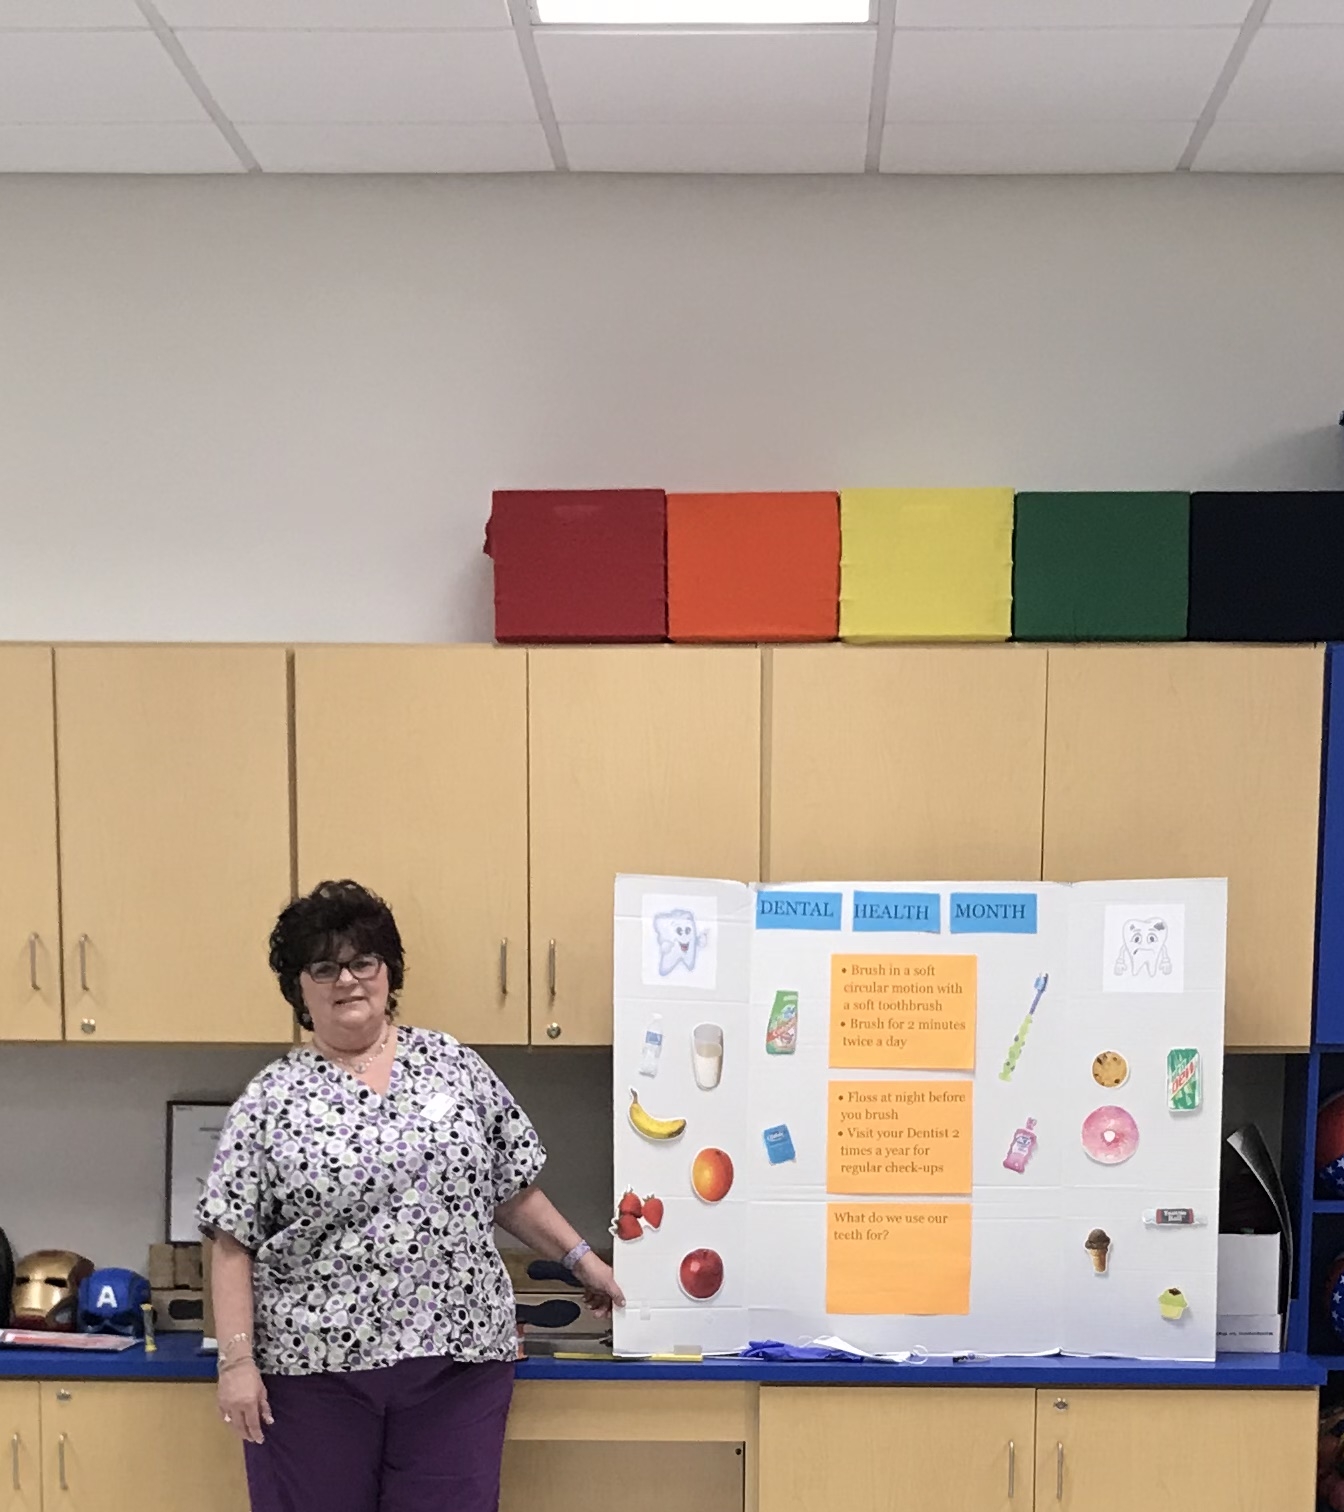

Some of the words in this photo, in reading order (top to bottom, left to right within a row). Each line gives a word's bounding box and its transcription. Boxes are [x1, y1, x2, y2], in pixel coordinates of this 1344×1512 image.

[760, 900, 834, 918] DENTAL
[854, 903, 930, 920] HEALTH
[955, 903, 1026, 919] MONTH
[851, 964, 886, 976] Brush
[889, 964, 901, 976] in
[903, 967, 910, 976] a
[913, 964, 936, 976] soft
[843, 981, 889, 994] circular
[892, 983, 934, 994] motion
[937, 982, 963, 994] with
[843, 1002, 850, 1011] a
[853, 999, 875, 1011] soft
[878, 1000, 943, 1012] toothbrush
[850, 1017, 885, 1030] Brush
[888, 1018, 905, 1030] for
[907, 1021, 915, 1030] 2
[918, 1019, 966, 1030] minutes
[842, 1035, 874, 1047] twice
[876, 1038, 883, 1047] a
[886, 1035, 908, 1050] day
[848, 1091, 878, 1103] Floss
[880, 1092, 892, 1103] at
[895, 1091, 925, 1105] night
[928, 1091, 966, 1103] before
[840, 1111, 862, 1123] you
[865, 1108, 899, 1120] brush
[847, 1127, 874, 1139] Visit
[877, 1130, 904, 1141] your
[907, 1127, 949, 1139] Dentist
[952, 1130, 960, 1139] 2
[840, 1145, 873, 1156] times
[875, 1147, 882, 1156] a
[884, 1147, 911, 1158] year
[913, 1144, 931, 1156] for
[840, 1161, 883, 1175] regular
[884, 1161, 944, 1175] check-ups
[834, 1211, 866, 1223] What
[868, 1211, 884, 1223] do
[885, 1214, 902, 1224] we
[905, 1215, 925, 1224] use
[927, 1214, 949, 1224] our
[833, 1228, 863, 1241] teeth
[866, 1228, 890, 1241] for?
[96, 1285, 118, 1308] A
